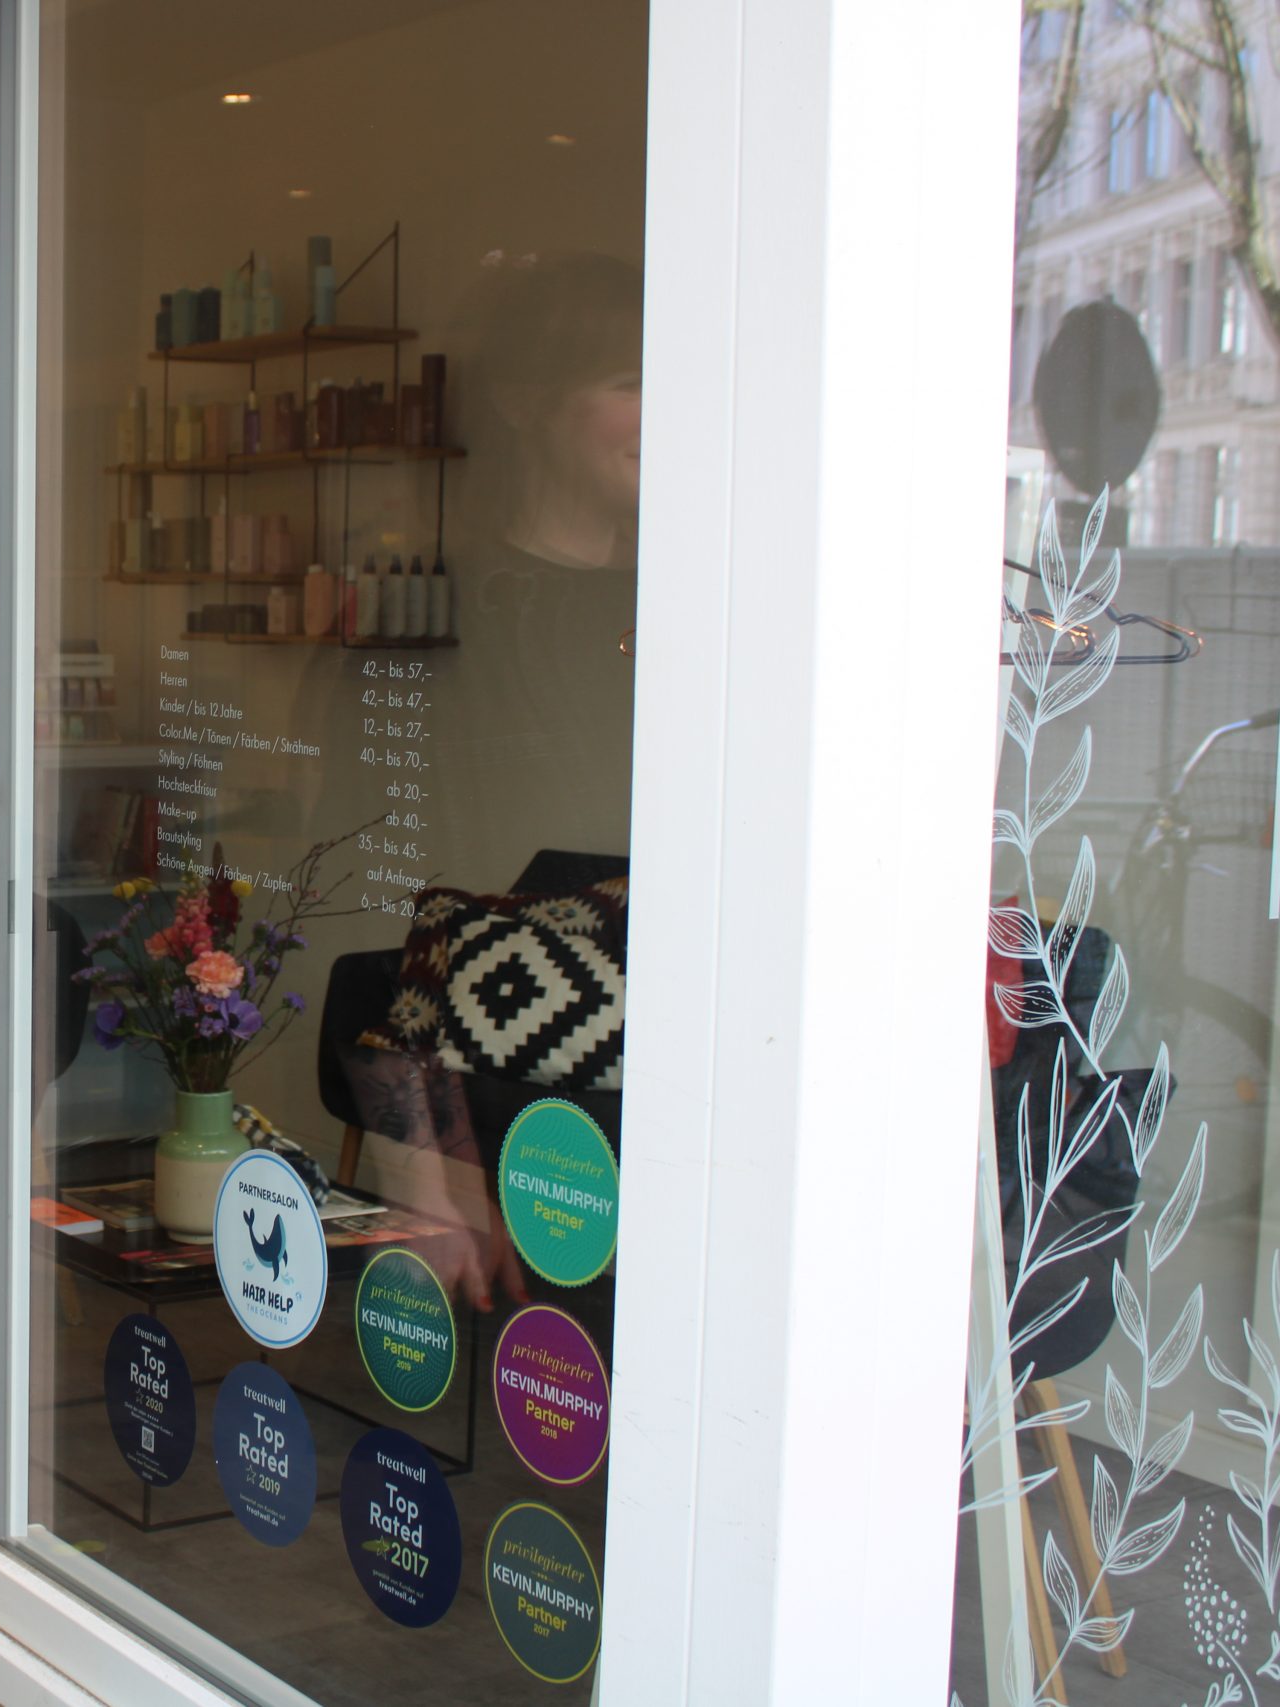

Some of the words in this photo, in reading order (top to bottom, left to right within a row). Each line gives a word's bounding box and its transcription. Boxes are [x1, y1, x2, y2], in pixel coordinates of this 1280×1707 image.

[161, 645, 189, 661] Damen
[160, 672, 187, 687] Herren
[389, 660, 404, 678] bis
[159, 698, 185, 713] Kinder
[194, 700, 206, 716] bis
[210, 702, 218, 717] 12
[220, 704, 243, 720] Jahre
[388, 689, 403, 708] bis
[159, 723, 198, 742] Color.Me
[207, 729, 232, 745] Tönen
[241, 733, 270, 750] Färben
[281, 738, 320, 757] Strähnen
[387, 719, 402, 737] bis
[158, 749, 185, 769] Styling
[194, 754, 223, 771] Föhnen
[386, 748, 401, 767] bis
[158, 775, 217, 798] Hochsteckfrisur
[386, 779, 400, 797] ab
[157, 801, 196, 823] Make-up
[385, 809, 399, 826] ab
[157, 826, 202, 851] Brautstyling
[384, 837, 398, 855] bis
[157, 852, 185, 871] Schöne
[188, 860, 214, 879] Augen
[224, 865, 252, 884] Färben
[263, 873, 292, 894] Zupfen
[367, 865, 383, 881] auf
[385, 868, 426, 893] Anfrage
[381, 895, 396, 914] bis
[520, 1143, 604, 1180] privilegierter
[239, 1181, 298, 1210] PARTNERSALON
[508, 1169, 613, 1217] KEVIN.MURPHY
[533, 1200, 584, 1231] Partner
[242, 1281, 266, 1305] HAIR
[268, 1289, 294, 1314] HELP
[370, 1284, 441, 1318] privilegierter
[134, 1325, 166, 1348] treatwell
[361, 1307, 448, 1351] KEVIN.MURPHY
[141, 1345, 166, 1379] Top
[383, 1336, 425, 1364] Partner
[511, 1342, 594, 1384] privilegierter
[130, 1362, 168, 1400] Rated
[501, 1367, 603, 1421] KEVIN.MURPHY
[145, 1395, 164, 1414] 2020
[243, 1384, 286, 1414] treatwell
[526, 1399, 575, 1433] Partner
[253, 1412, 285, 1454] Top
[541, 1425, 558, 1440] 2018
[239, 1432, 288, 1479] Rated
[376, 1451, 426, 1484] treatwell
[259, 1473, 281, 1496] 2019
[246, 1504, 279, 1527] treatwell.de
[385, 1482, 419, 1525] Top
[370, 1500, 423, 1549] Rated
[391, 1542, 429, 1578] 2017
[503, 1539, 585, 1584] privilegierter
[379, 1580, 416, 1606] treatwell.de
[493, 1562, 594, 1622] KEVIN.MURPHY
[517, 1596, 567, 1632] Partner
[533, 1623, 550, 1638] 2017
